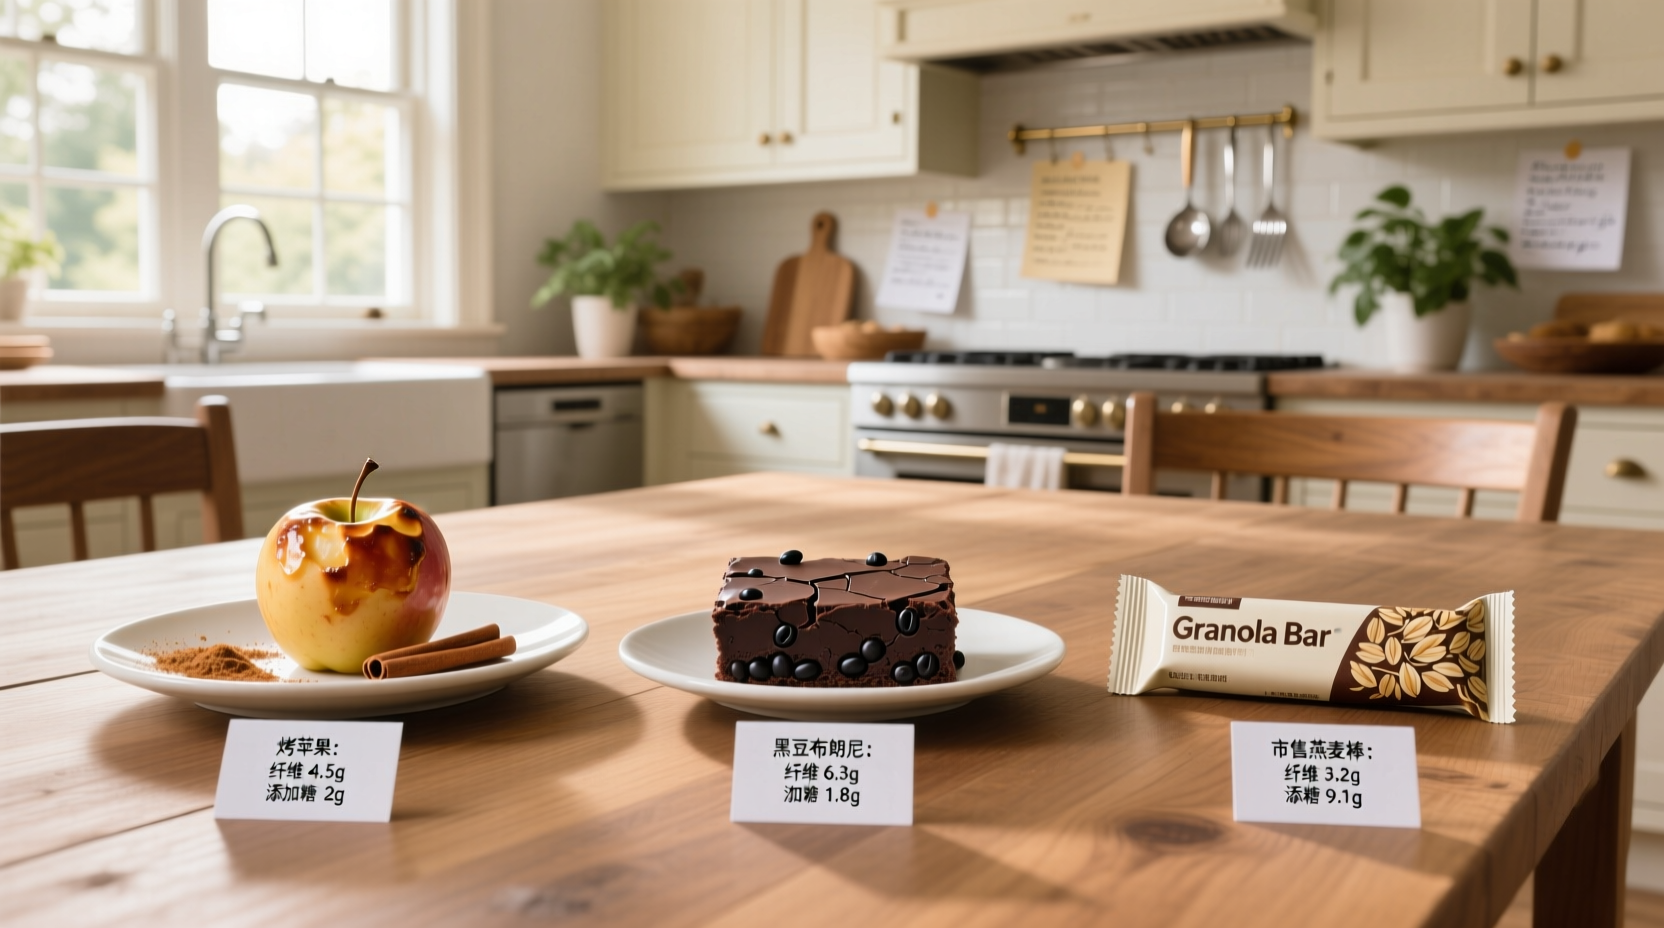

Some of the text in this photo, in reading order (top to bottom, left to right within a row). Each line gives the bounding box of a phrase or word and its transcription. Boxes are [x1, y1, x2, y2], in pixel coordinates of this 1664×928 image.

[1173, 616, 1332, 648] Granola Bar
[268, 762, 346, 783] 纤维 4.5g
[784, 763, 859, 785] 纤维 6.3g
[1284, 764, 1360, 786] 纤维 3.2g
[266, 783, 345, 806] 添加糖 2g
[826, 787, 860, 807] 1.8g
[1326, 789, 1362, 809] 9.1g
